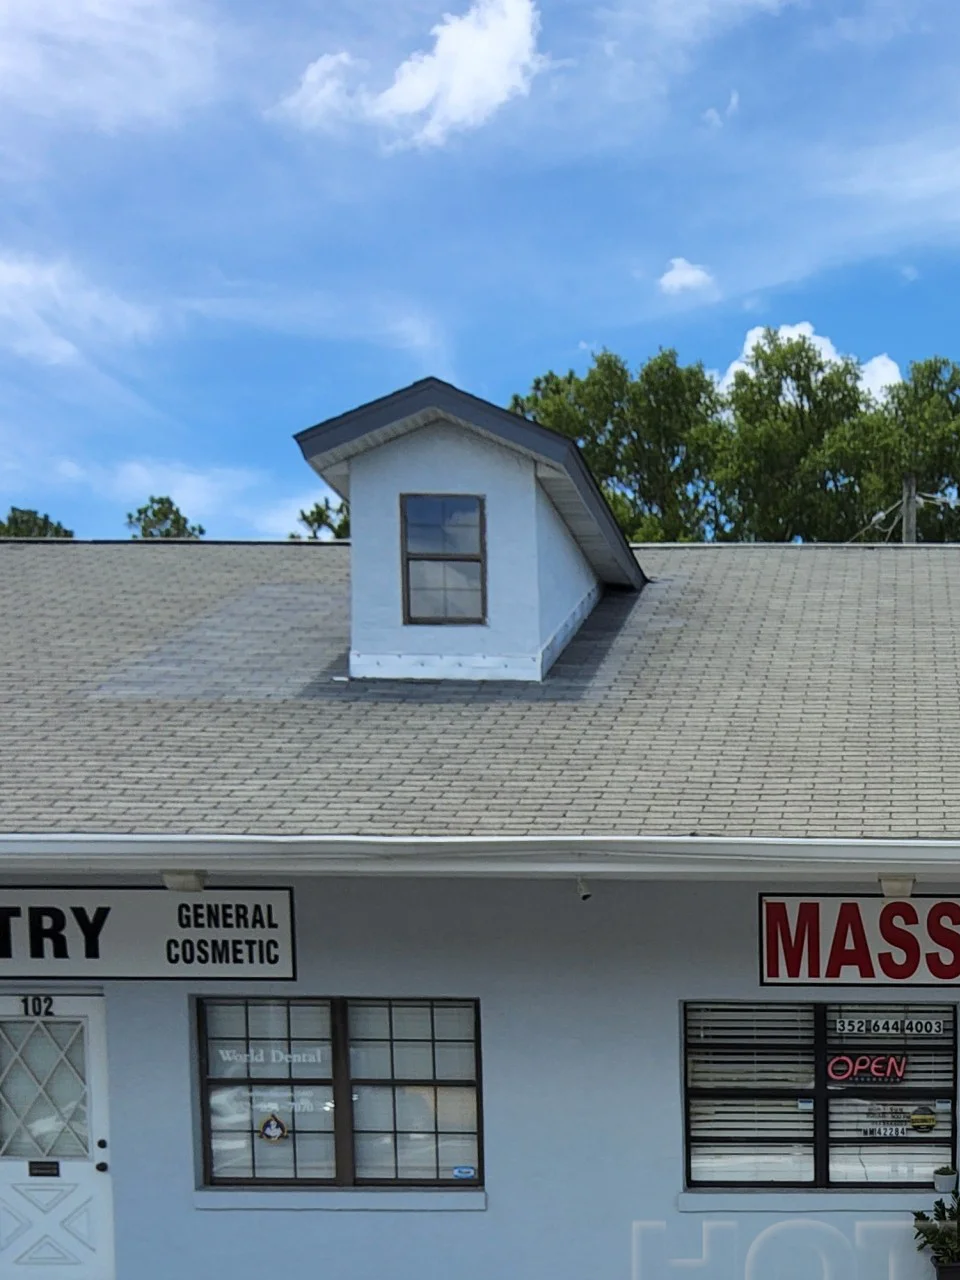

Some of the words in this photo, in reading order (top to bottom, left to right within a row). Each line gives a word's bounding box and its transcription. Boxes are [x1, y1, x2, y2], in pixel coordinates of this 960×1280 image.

[178, 903, 278, 929] GENERAL
[166, 939, 280, 965] COSMETIC
[21, 996, 54, 1016] 102
[837, 1020, 865, 1033] 352
[872, 1020, 900, 1033] 644
[906, 1021, 942, 1034] 4003
[218, 1048, 264, 1062] World
[271, 1049, 321, 1062] Dental
[827, 1056, 907, 1080] OPEN
